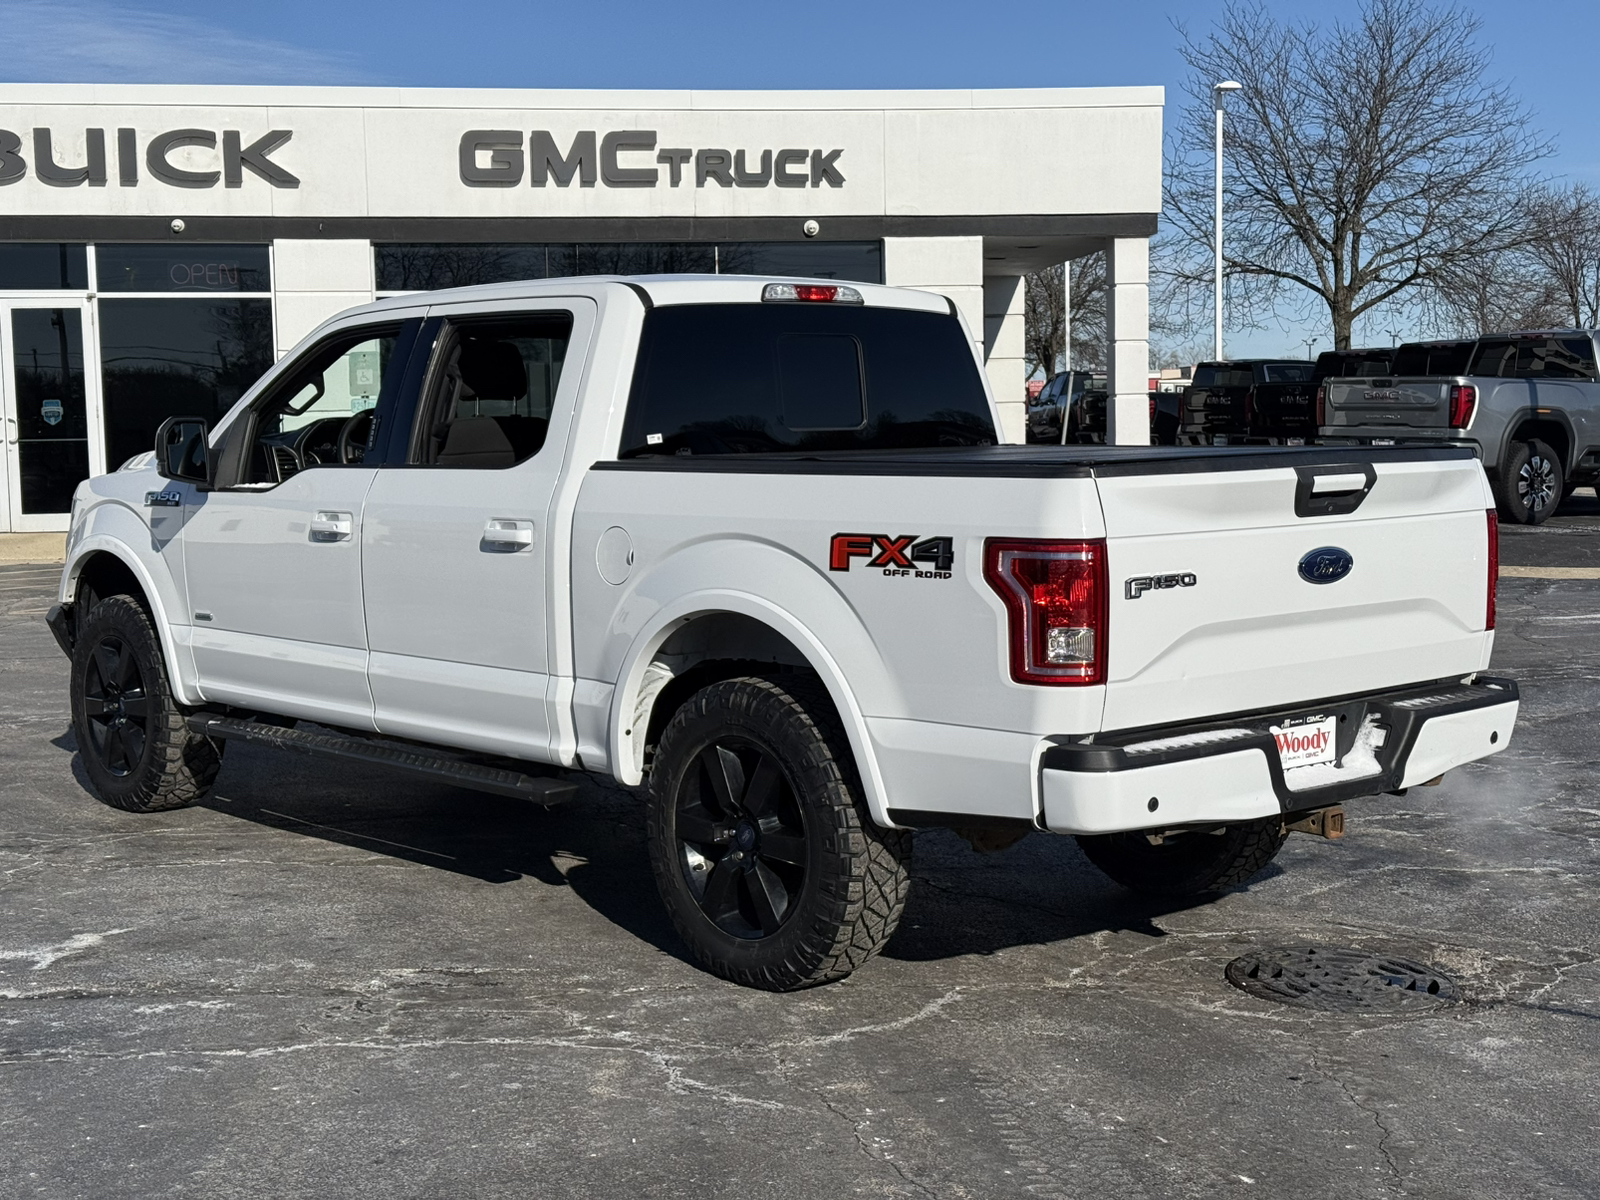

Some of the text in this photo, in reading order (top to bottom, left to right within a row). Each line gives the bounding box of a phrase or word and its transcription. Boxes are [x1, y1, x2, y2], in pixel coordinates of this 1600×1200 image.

[459, 130, 847, 188] GMC TRUCK
[170, 263, 239, 285] OPEN
[829, 532, 954, 572] FX4
[882, 568, 953, 580] OFF ROAD
[1306, 714, 1324, 723] GMC
[1274, 727, 1331, 754] Woody
